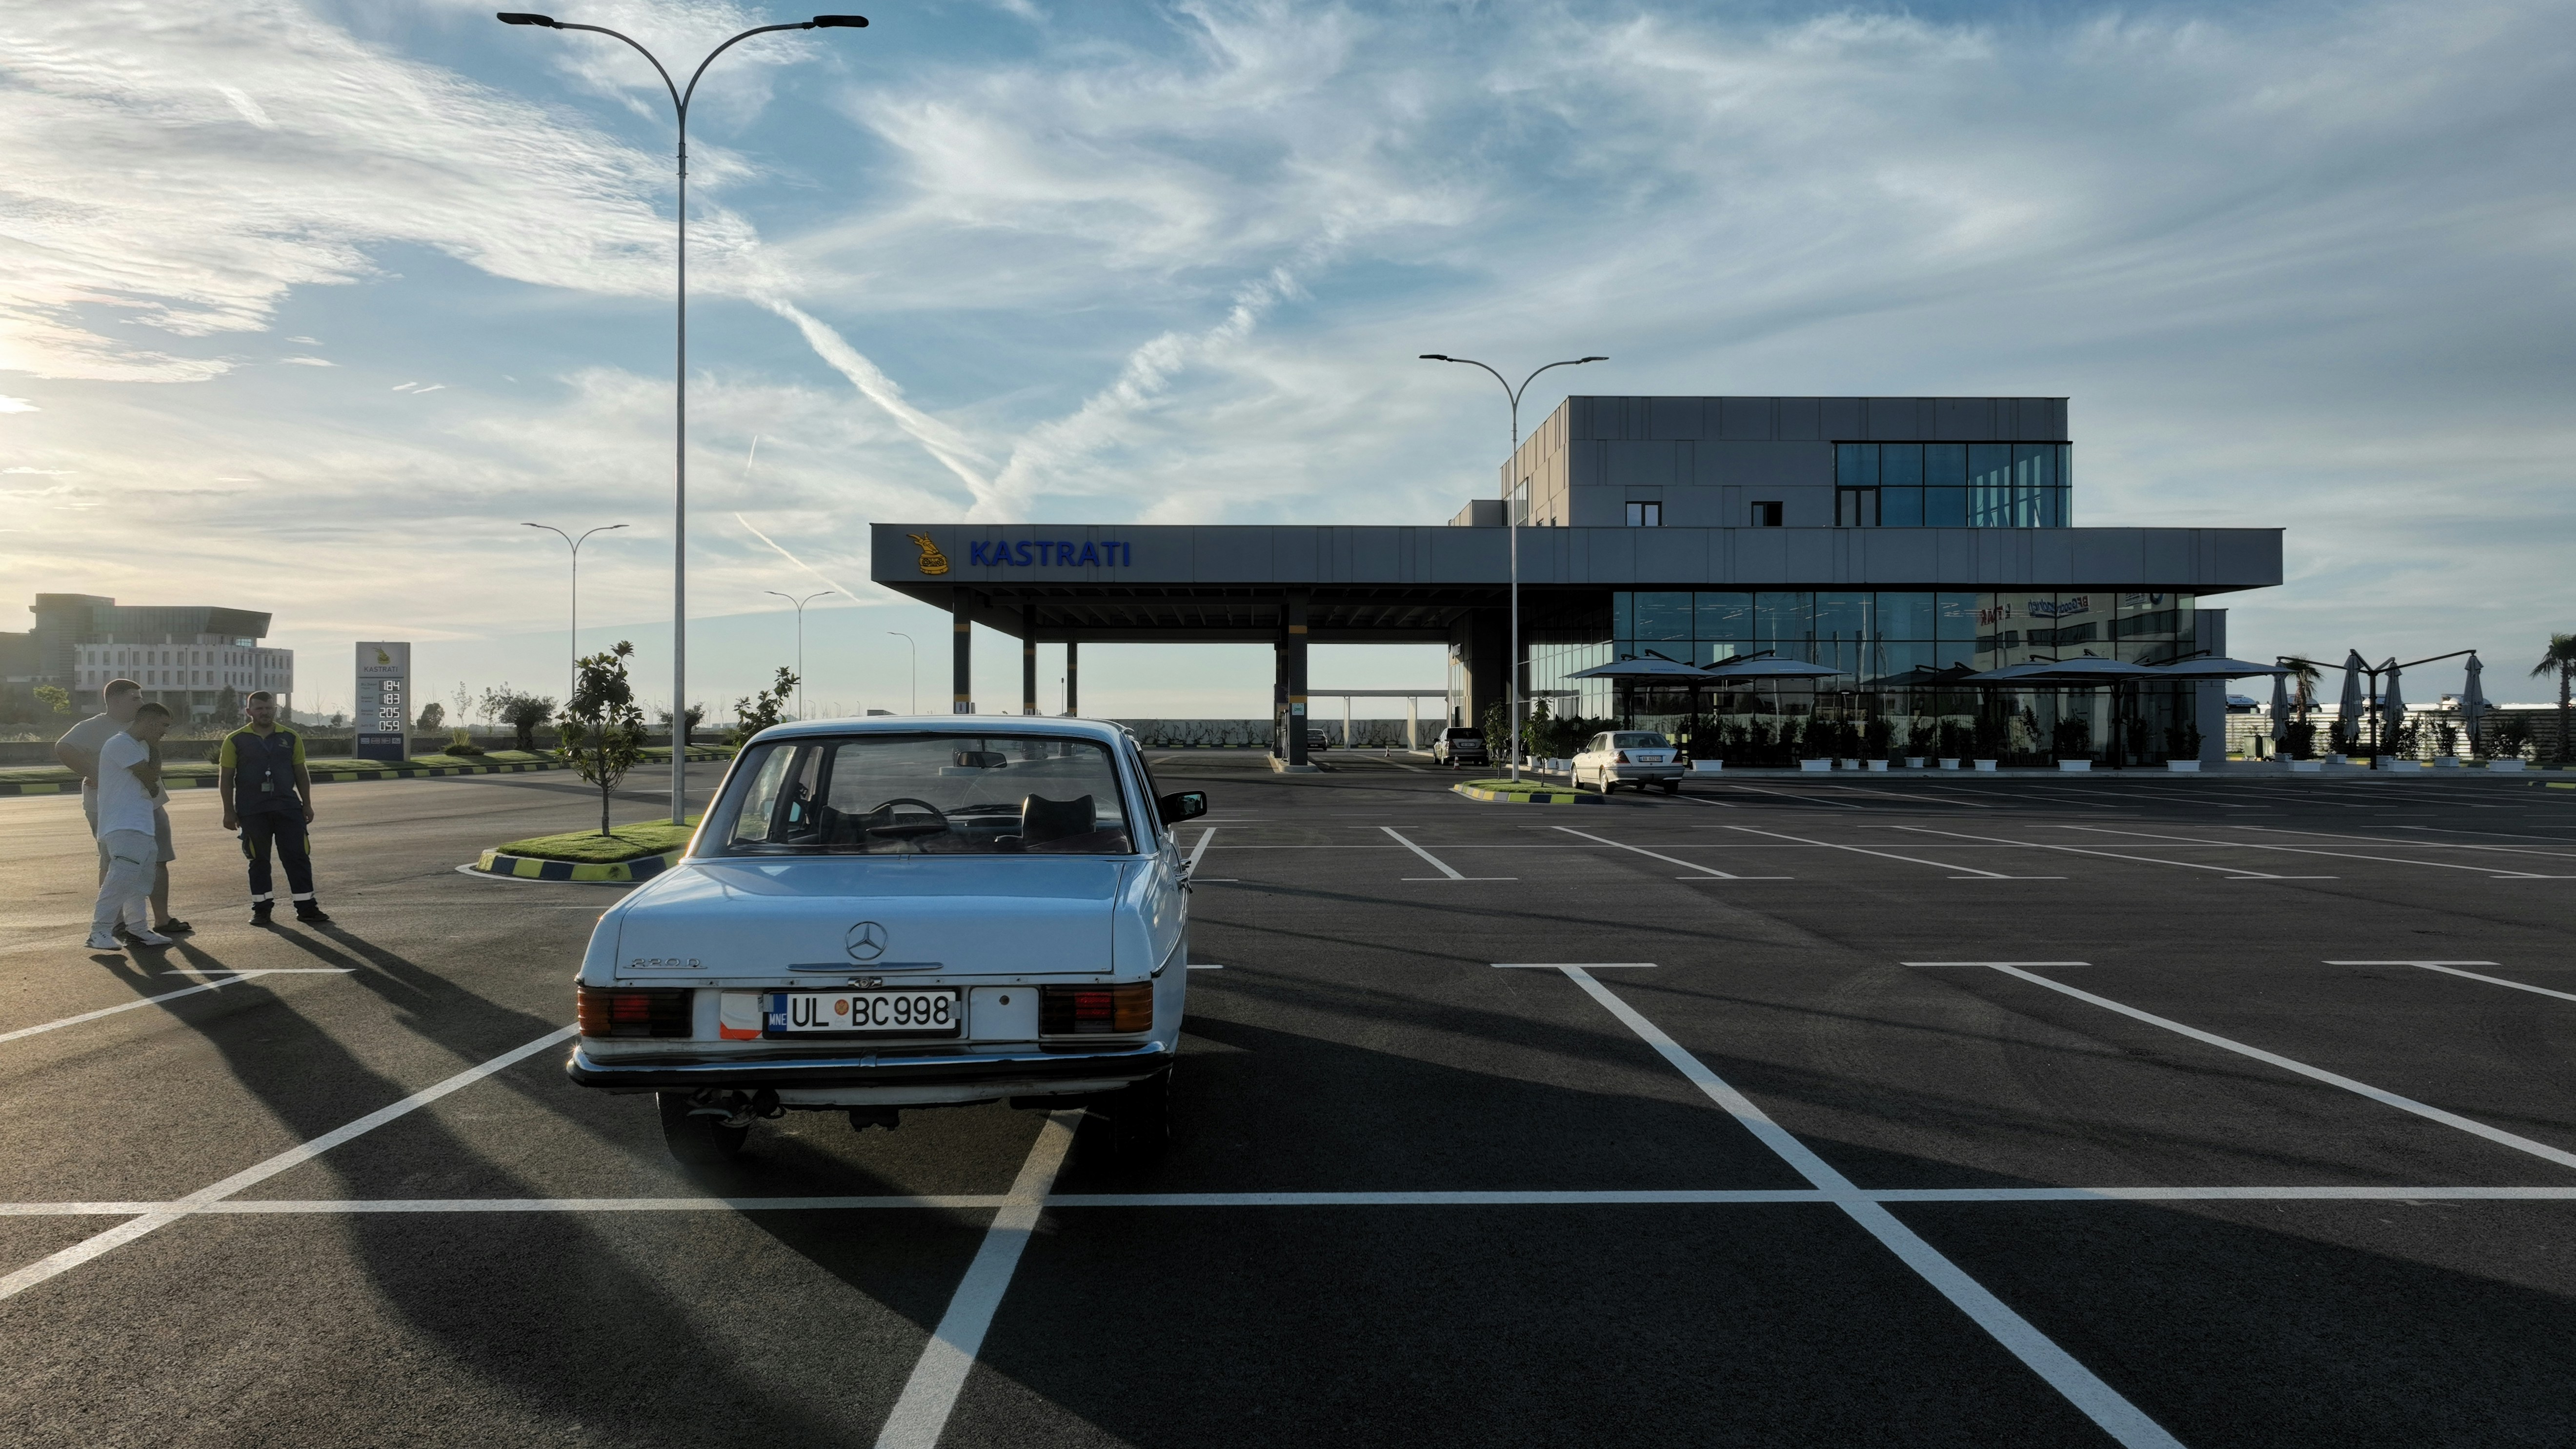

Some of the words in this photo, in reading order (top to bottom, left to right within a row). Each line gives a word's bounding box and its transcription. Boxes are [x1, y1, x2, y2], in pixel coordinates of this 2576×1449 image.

[970, 541, 1129, 566] KASTRATI
[383, 680, 400, 691] 184
[383, 693, 400, 704] 183
[379, 707, 400, 718] 205
[379, 721, 400, 731] 059
[792, 997, 829, 1027] UL
[852, 996, 949, 1026] BC998
[769, 1013, 787, 1026] MNE
